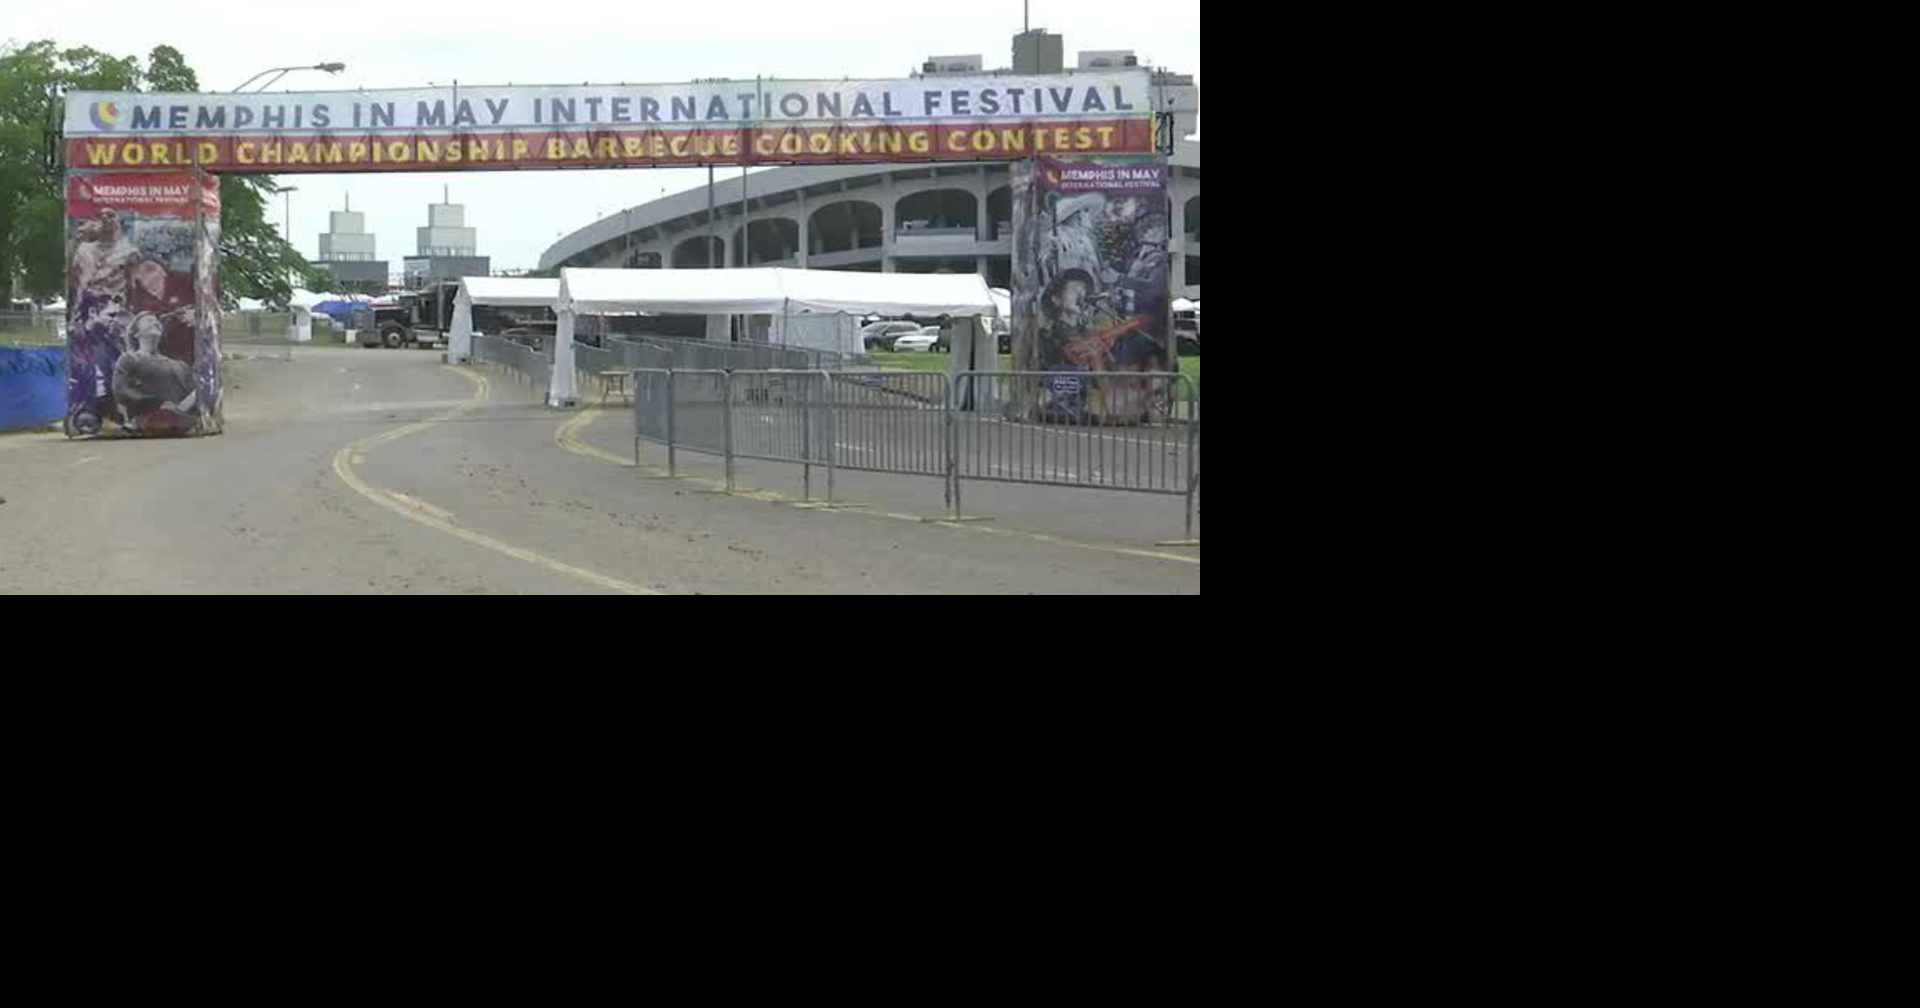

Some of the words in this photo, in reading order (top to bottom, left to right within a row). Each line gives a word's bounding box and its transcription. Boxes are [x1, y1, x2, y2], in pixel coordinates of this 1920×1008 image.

[130, 104, 331, 129] MEMPHIS
[352, 102, 396, 128] IN
[416, 98, 510, 127] MAY
[533, 92, 902, 123] INTERNATIONAL
[923, 85, 1133, 115] FESTIVAL
[87, 143, 219, 165] WORLD
[236, 139, 529, 164] CHAMPIONSHIP
[547, 134, 738, 158] BARBECUE
[756, 131, 930, 155] COOKING
[948, 127, 1116, 151] CONTEST
[1061, 170, 1115, 179] MEMPHIS
[1117, 169, 1131, 179] IN
[1133, 169, 1160, 179] MAY
[93, 185, 147, 196] MEMPHIS
[149, 185, 161, 196] IN
[163, 184, 190, 195] MAY
